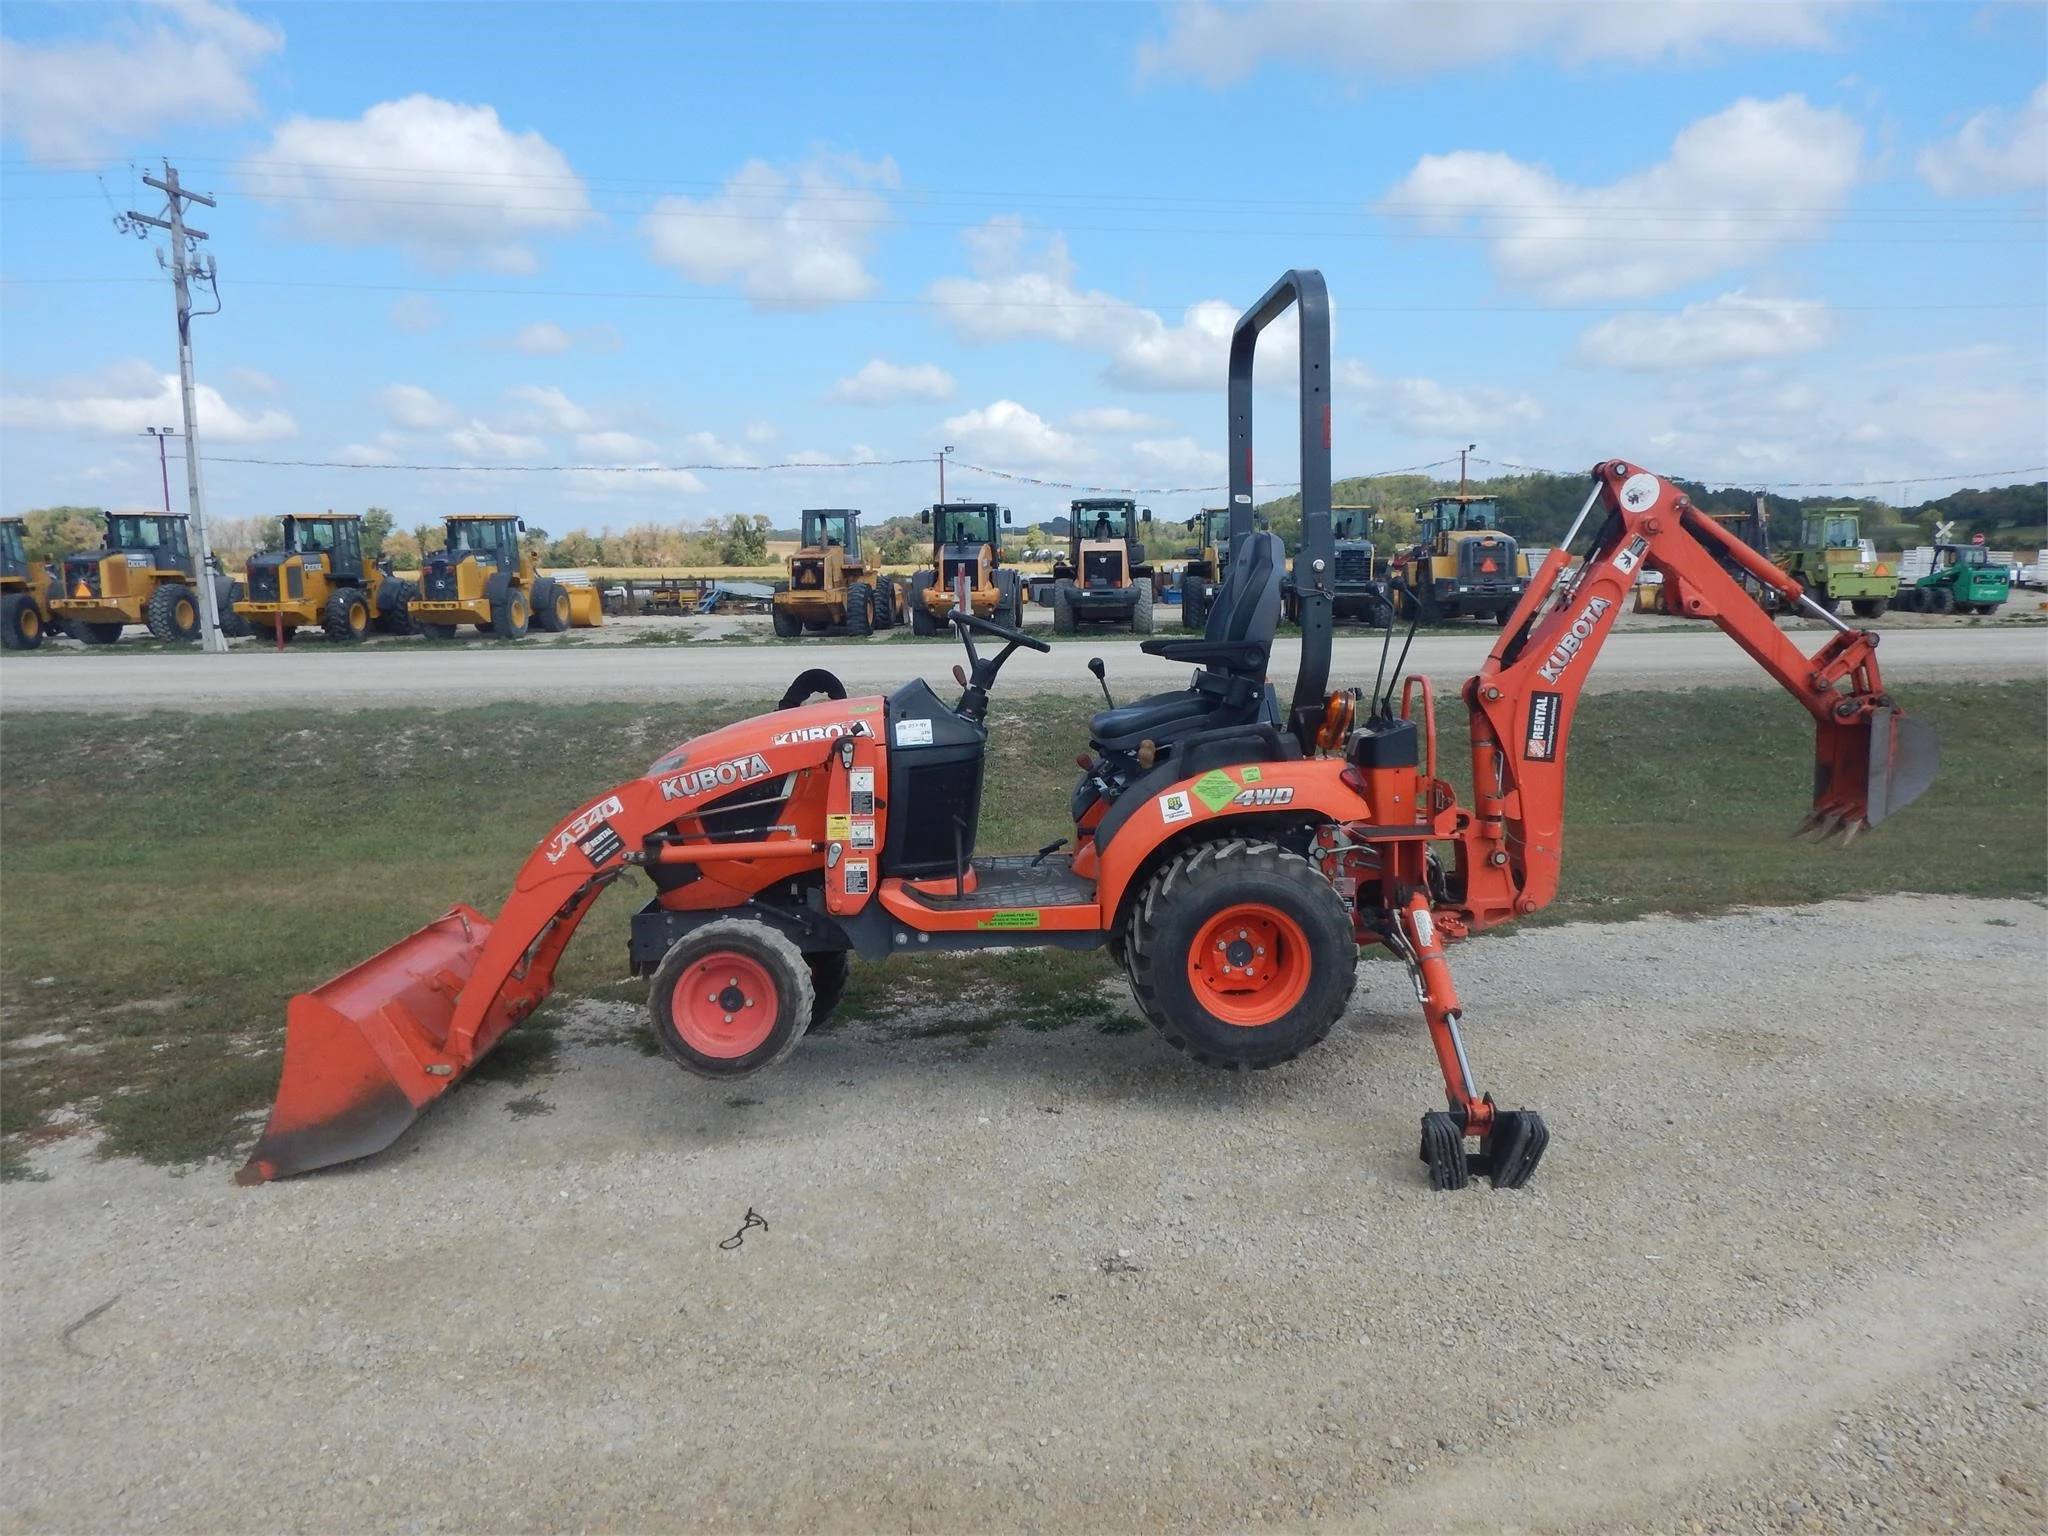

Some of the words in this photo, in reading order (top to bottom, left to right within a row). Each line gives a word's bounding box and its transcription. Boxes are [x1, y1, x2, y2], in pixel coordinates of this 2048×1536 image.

[1538, 597, 1612, 684] KUBOTA
[1533, 696, 1549, 739] RENTAL
[660, 754, 772, 801] KUBOTA
[1233, 788, 1294, 806] 4WD
[590, 828, 614, 847] RENTAL
